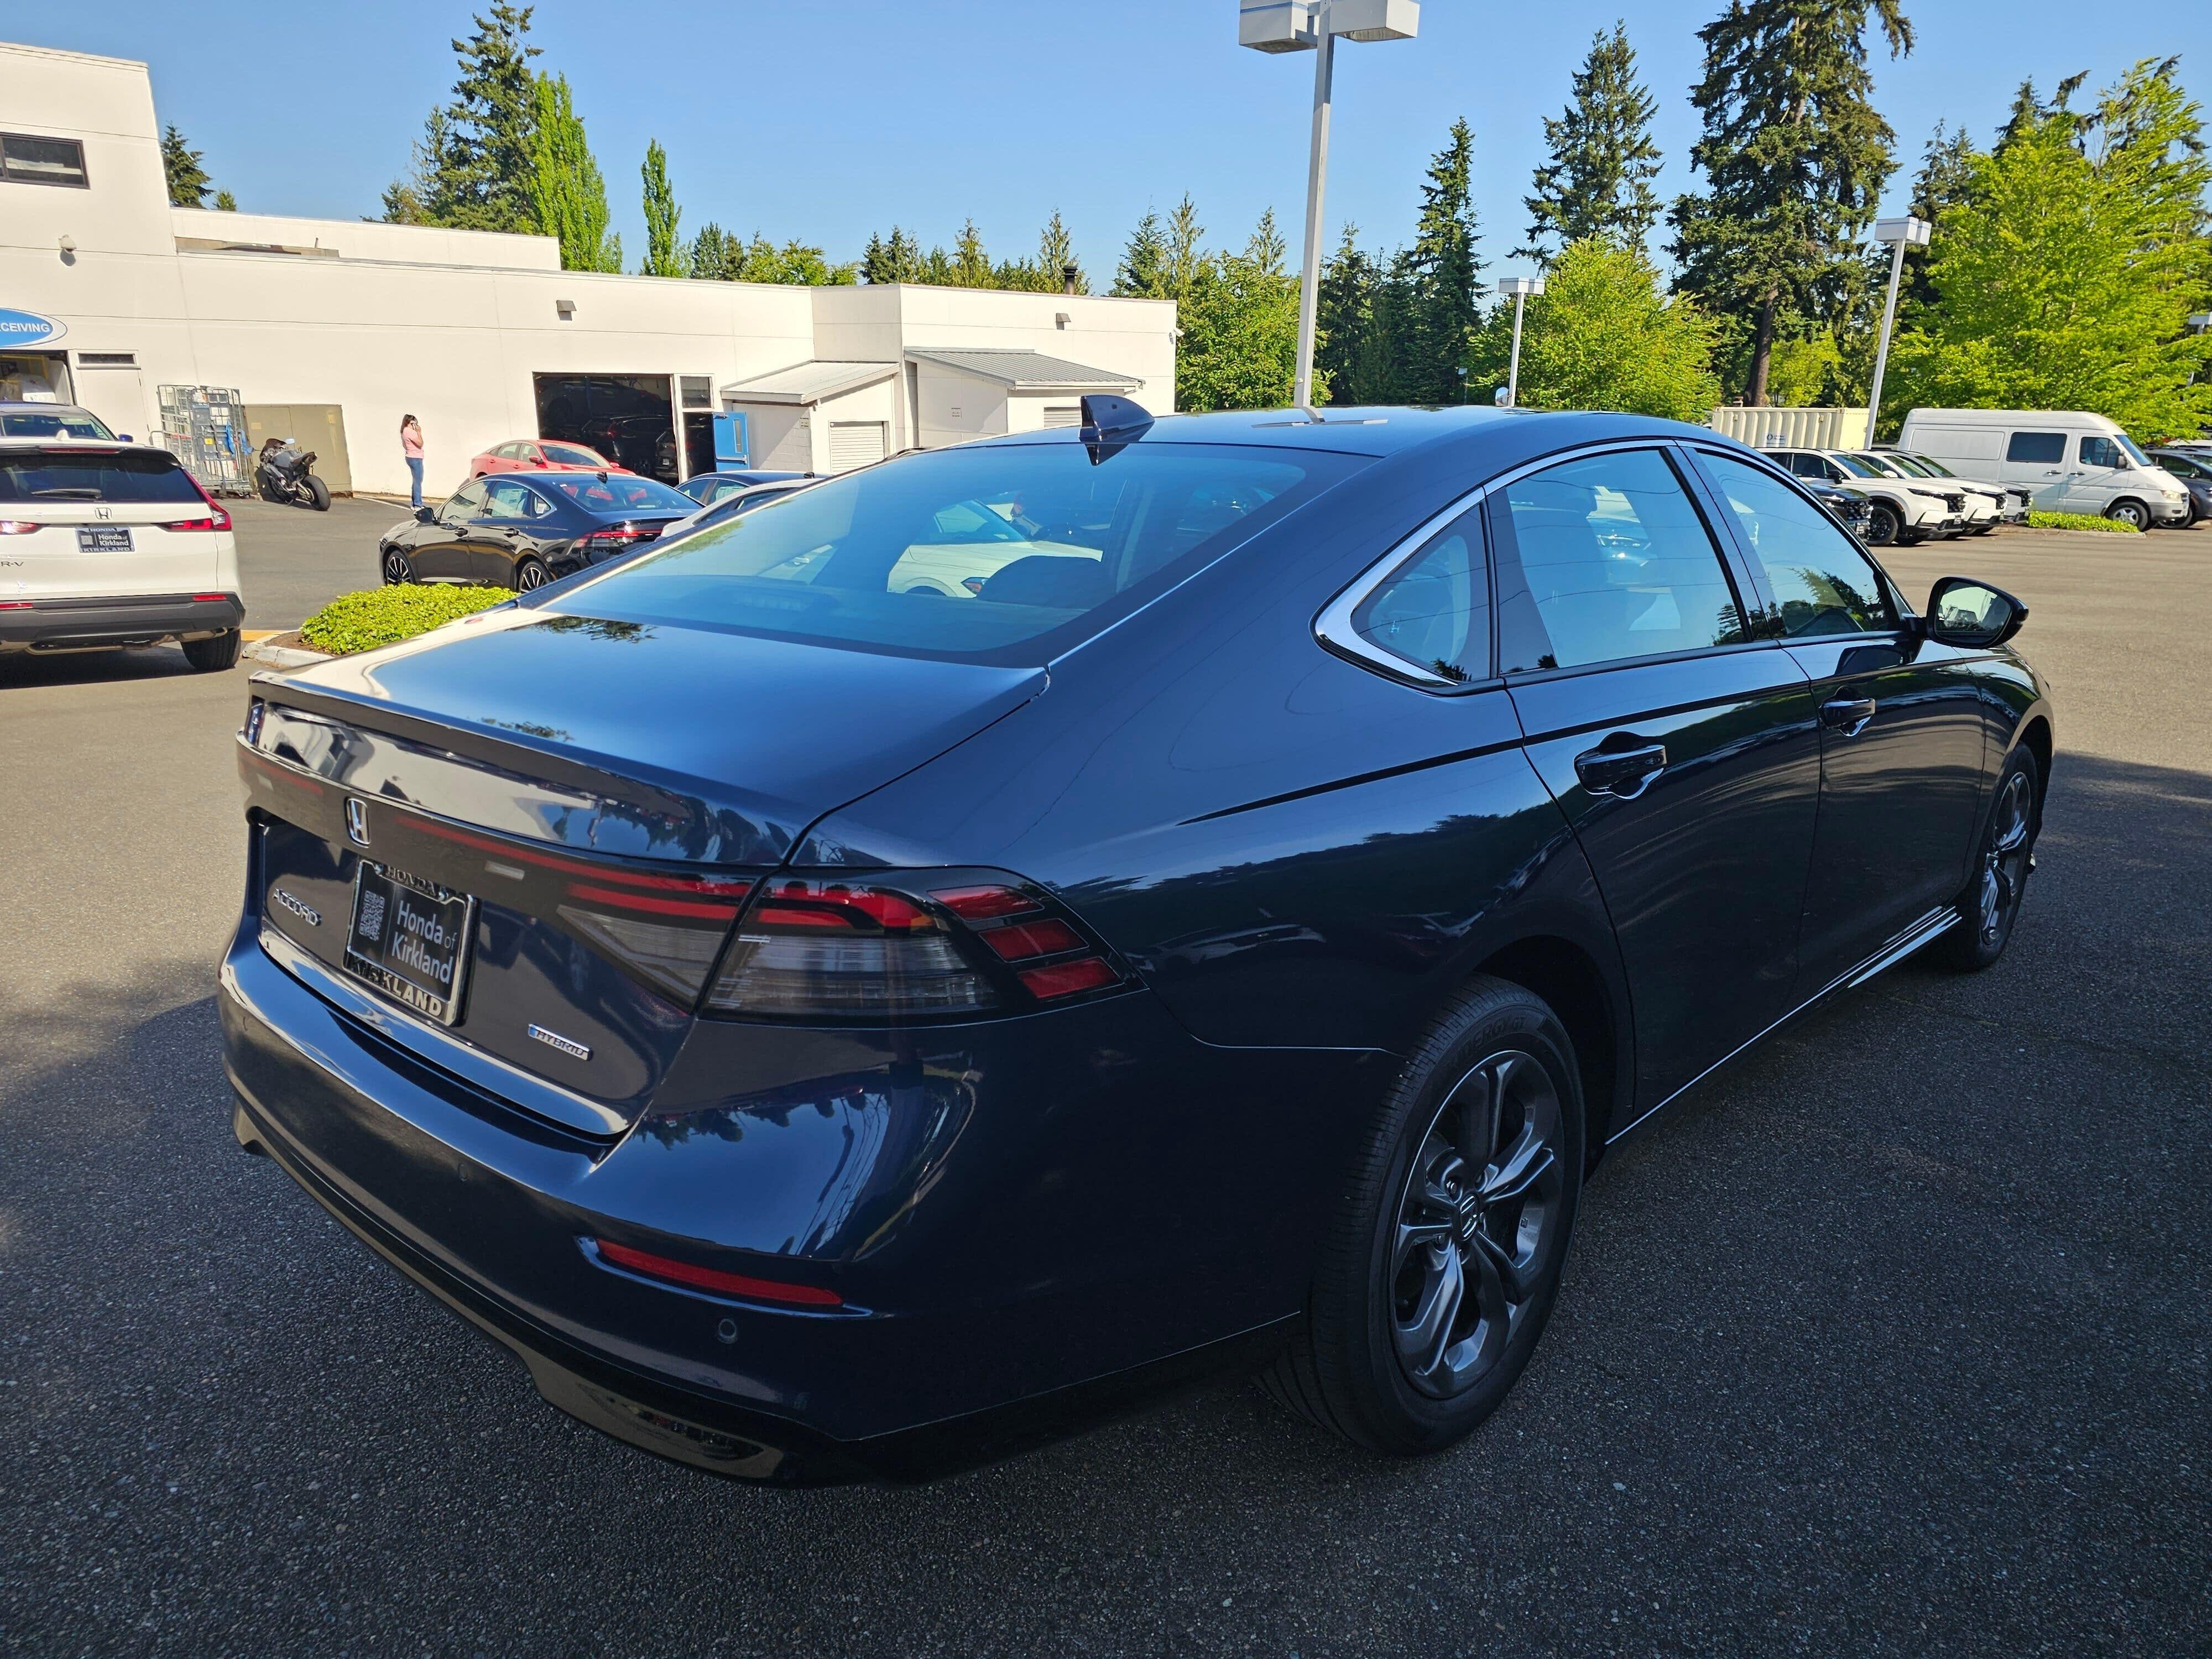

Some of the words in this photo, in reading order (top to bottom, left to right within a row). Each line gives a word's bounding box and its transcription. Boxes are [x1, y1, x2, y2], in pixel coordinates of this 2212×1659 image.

[0, 322, 50, 332] CEIVING
[386, 867, 436, 896] HONDA
[272, 888, 319, 926] ACCORD
[397, 900, 442, 945] Honda
[444, 932, 457, 950] of
[392, 932, 453, 984] Kirkland
[349, 956, 442, 1016] KIRKLAND
[536, 1031, 584, 1056] HYBRID
